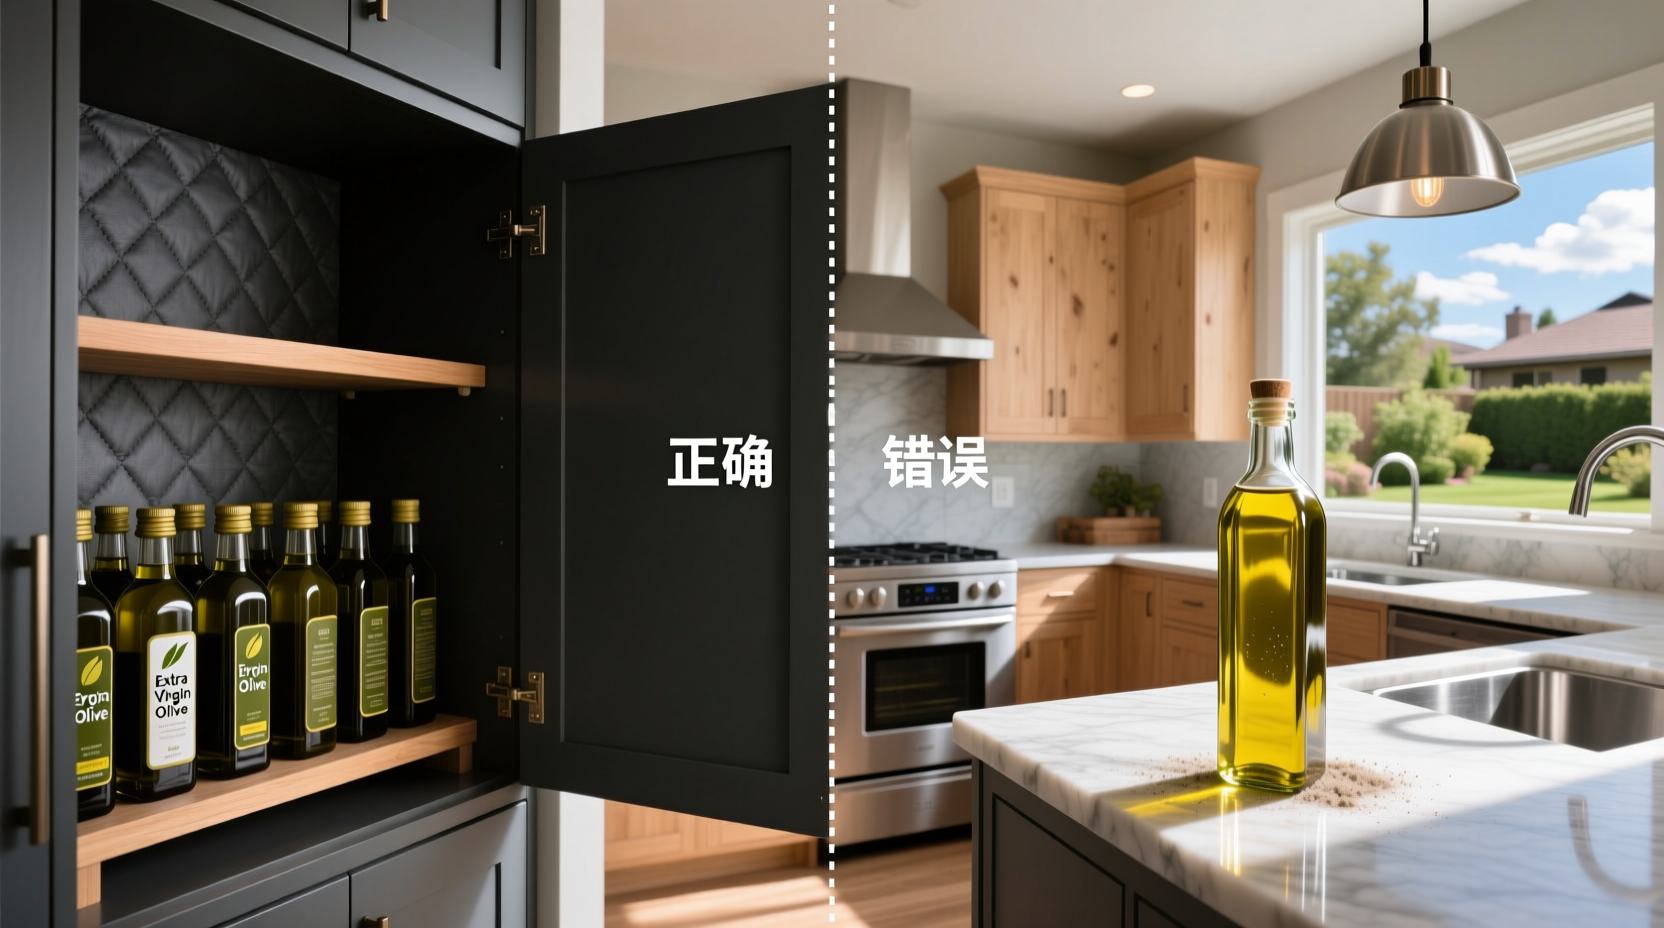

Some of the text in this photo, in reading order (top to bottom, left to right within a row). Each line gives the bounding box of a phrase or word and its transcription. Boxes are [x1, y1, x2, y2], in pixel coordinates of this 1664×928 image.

[155, 673, 188, 688] Extra
[239, 678, 267, 693] Olive
[154, 688, 191, 706] Virgin
[75, 706, 109, 724] Olive
[155, 704, 188, 719] Olive
